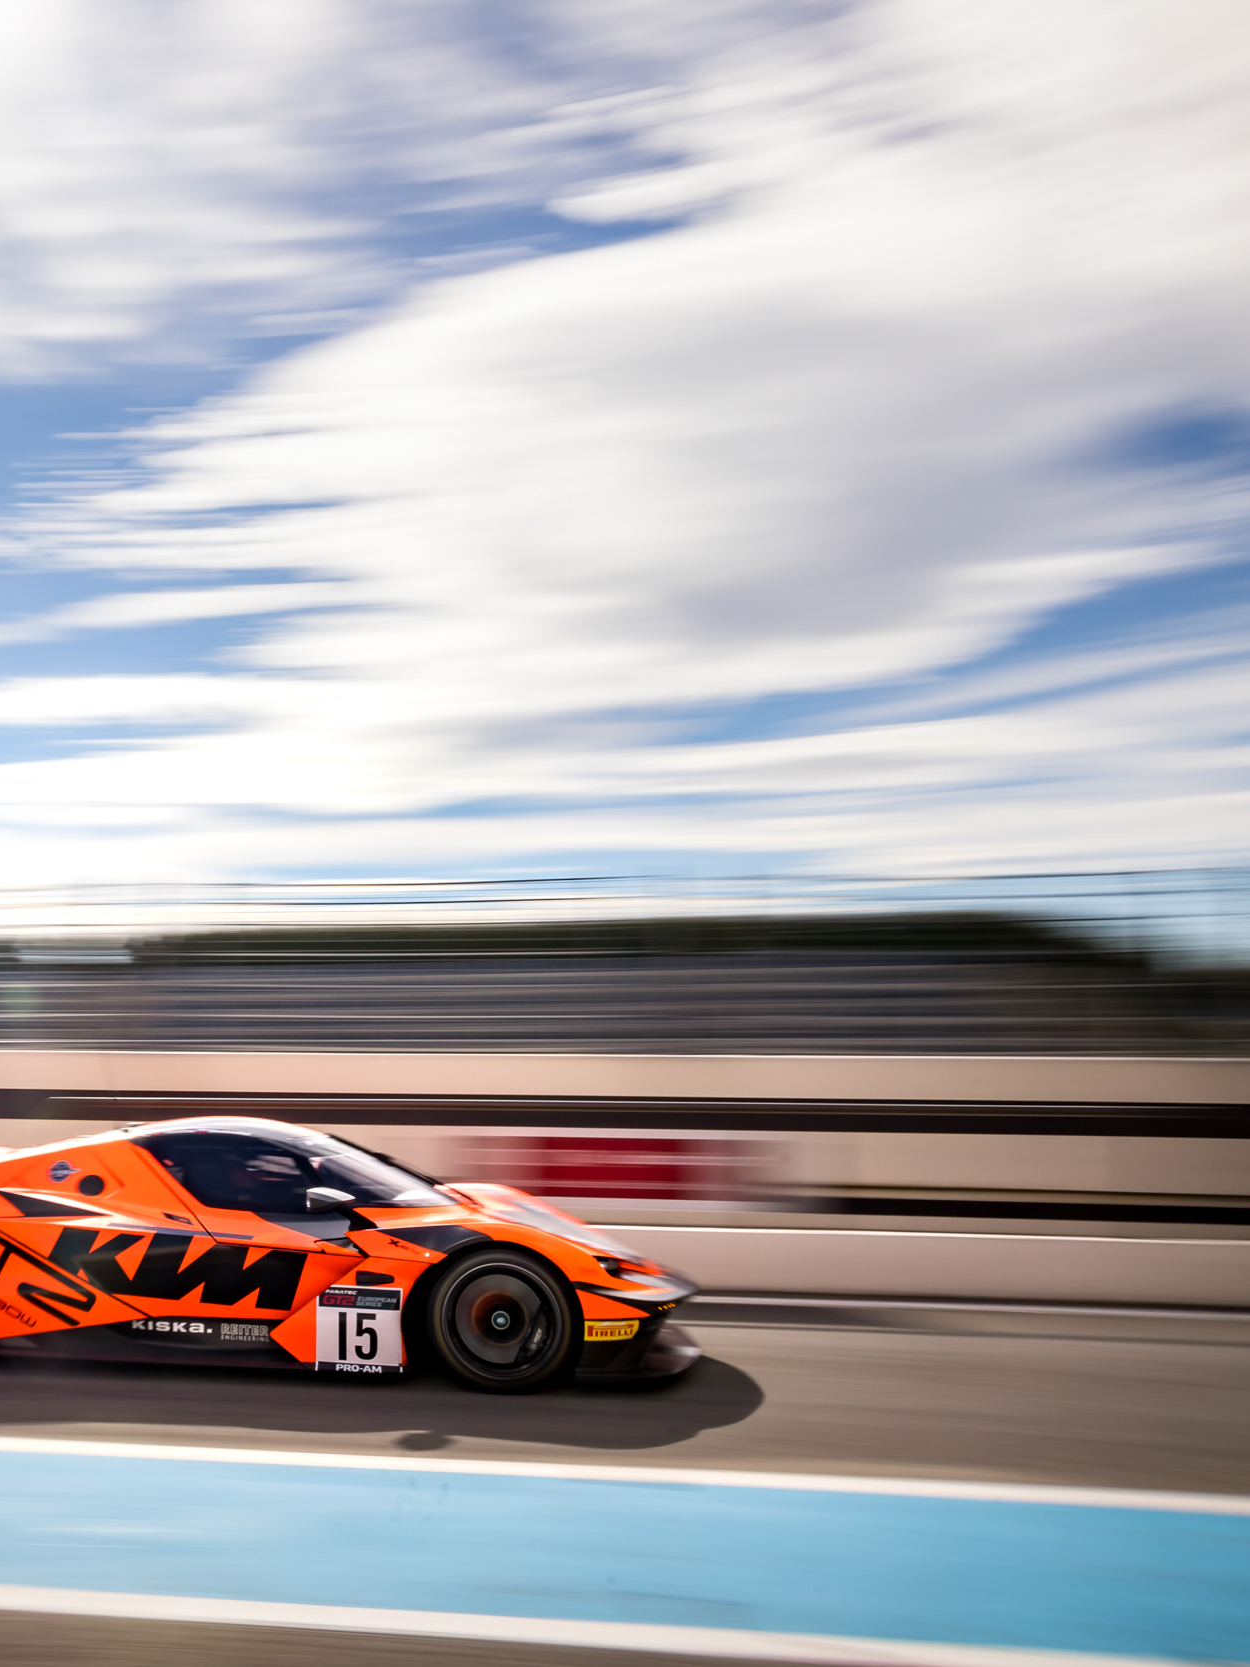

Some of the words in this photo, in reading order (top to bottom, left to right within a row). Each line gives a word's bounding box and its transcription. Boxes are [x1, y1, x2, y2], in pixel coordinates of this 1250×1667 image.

[46, 1226, 309, 1311] KTM
[322, 1294, 356, 1306] GT2
[356, 1296, 397, 1304] EUROPEAN
[220, 1323, 269, 1337] REITER
[338, 1311, 379, 1361] 15
[587, 1323, 635, 1338] PIRELLI
[220, 1334, 270, 1343] ENGINEERING
[335, 1363, 383, 1374] PRO-AM
